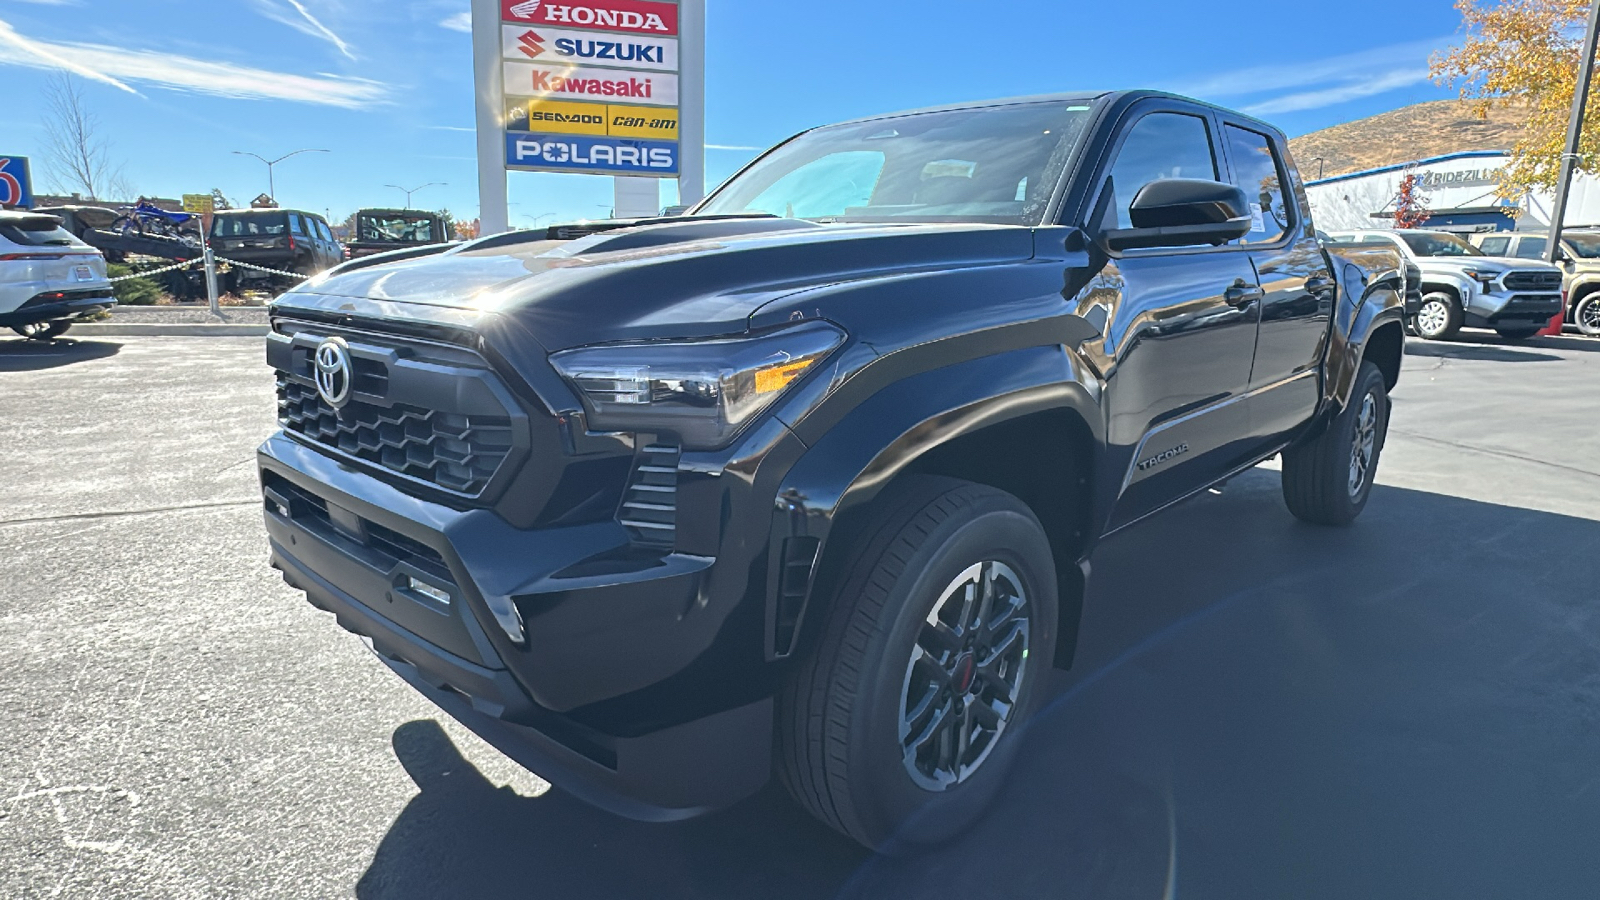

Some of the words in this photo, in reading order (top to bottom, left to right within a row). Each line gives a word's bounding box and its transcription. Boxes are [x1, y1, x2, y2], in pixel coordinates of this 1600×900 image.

[544, 4, 668, 31] HONDA
[555, 38, 663, 63] SUZUKI
[532, 70, 652, 98] Kawasaki
[613, 116, 676, 129] can-am
[516, 140, 673, 168] POLARIS
[1138, 443, 1189, 470] TACOMA
